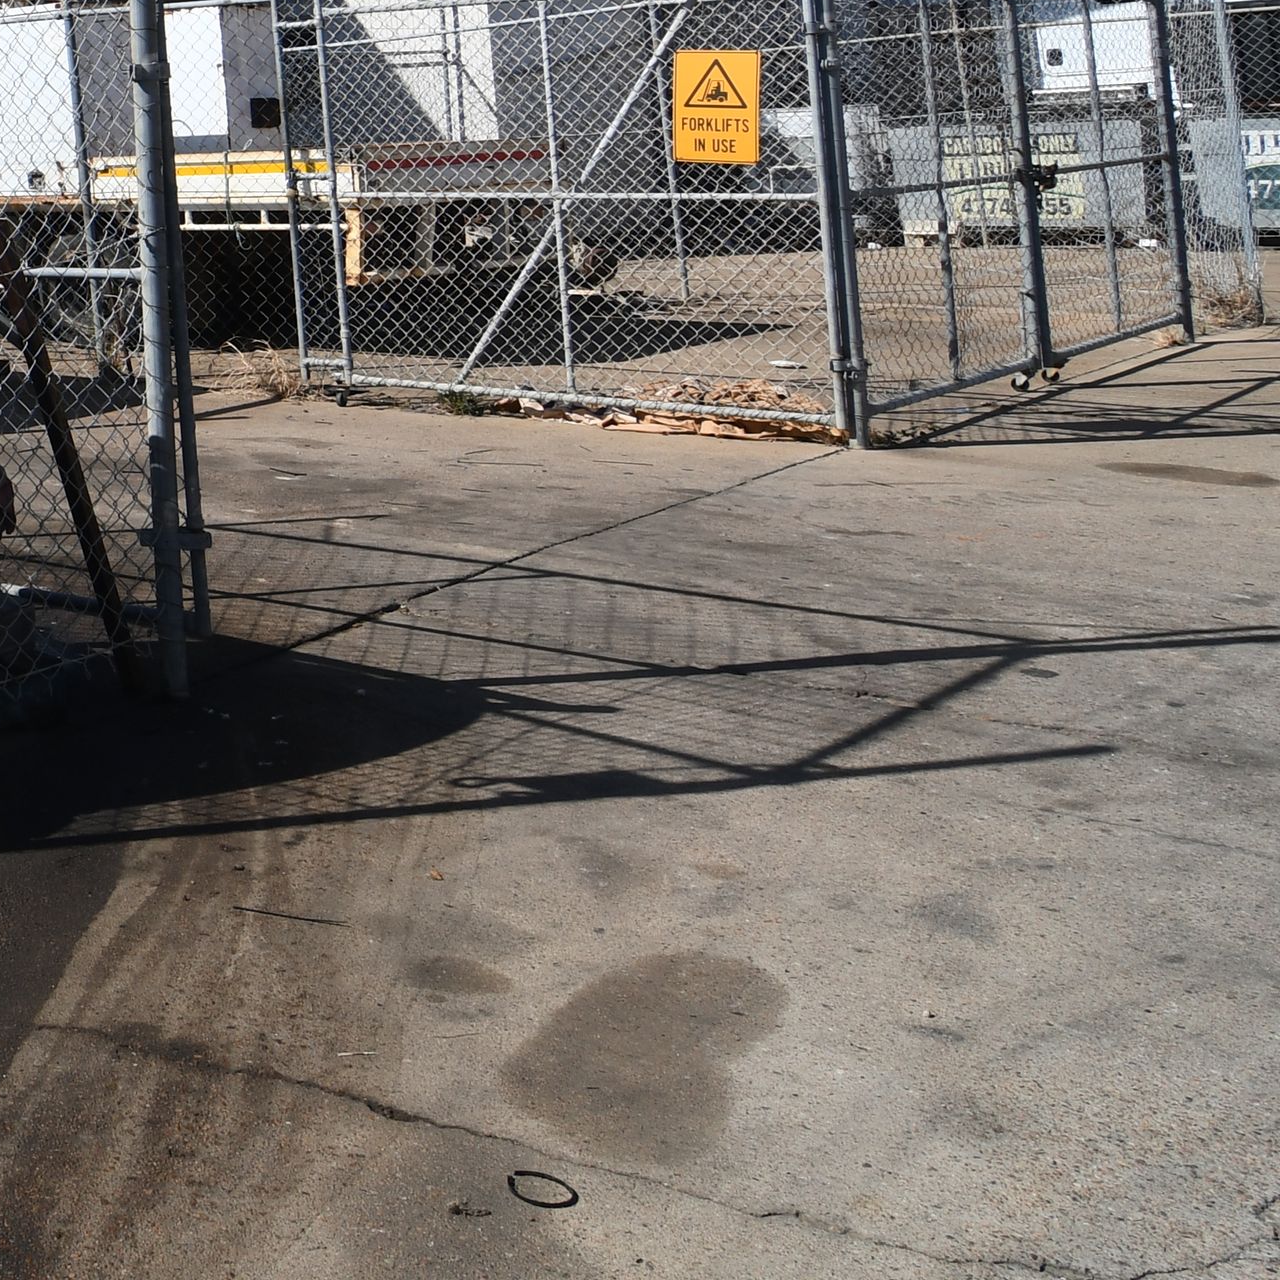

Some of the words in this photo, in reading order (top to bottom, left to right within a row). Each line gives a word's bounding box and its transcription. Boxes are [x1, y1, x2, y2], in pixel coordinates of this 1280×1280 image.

[681, 117, 750, 133] FORKLIFTS
[694, 138, 706, 152] IN
[712, 139, 737, 153] USE
[1039, 134, 1076, 152] ONLY
